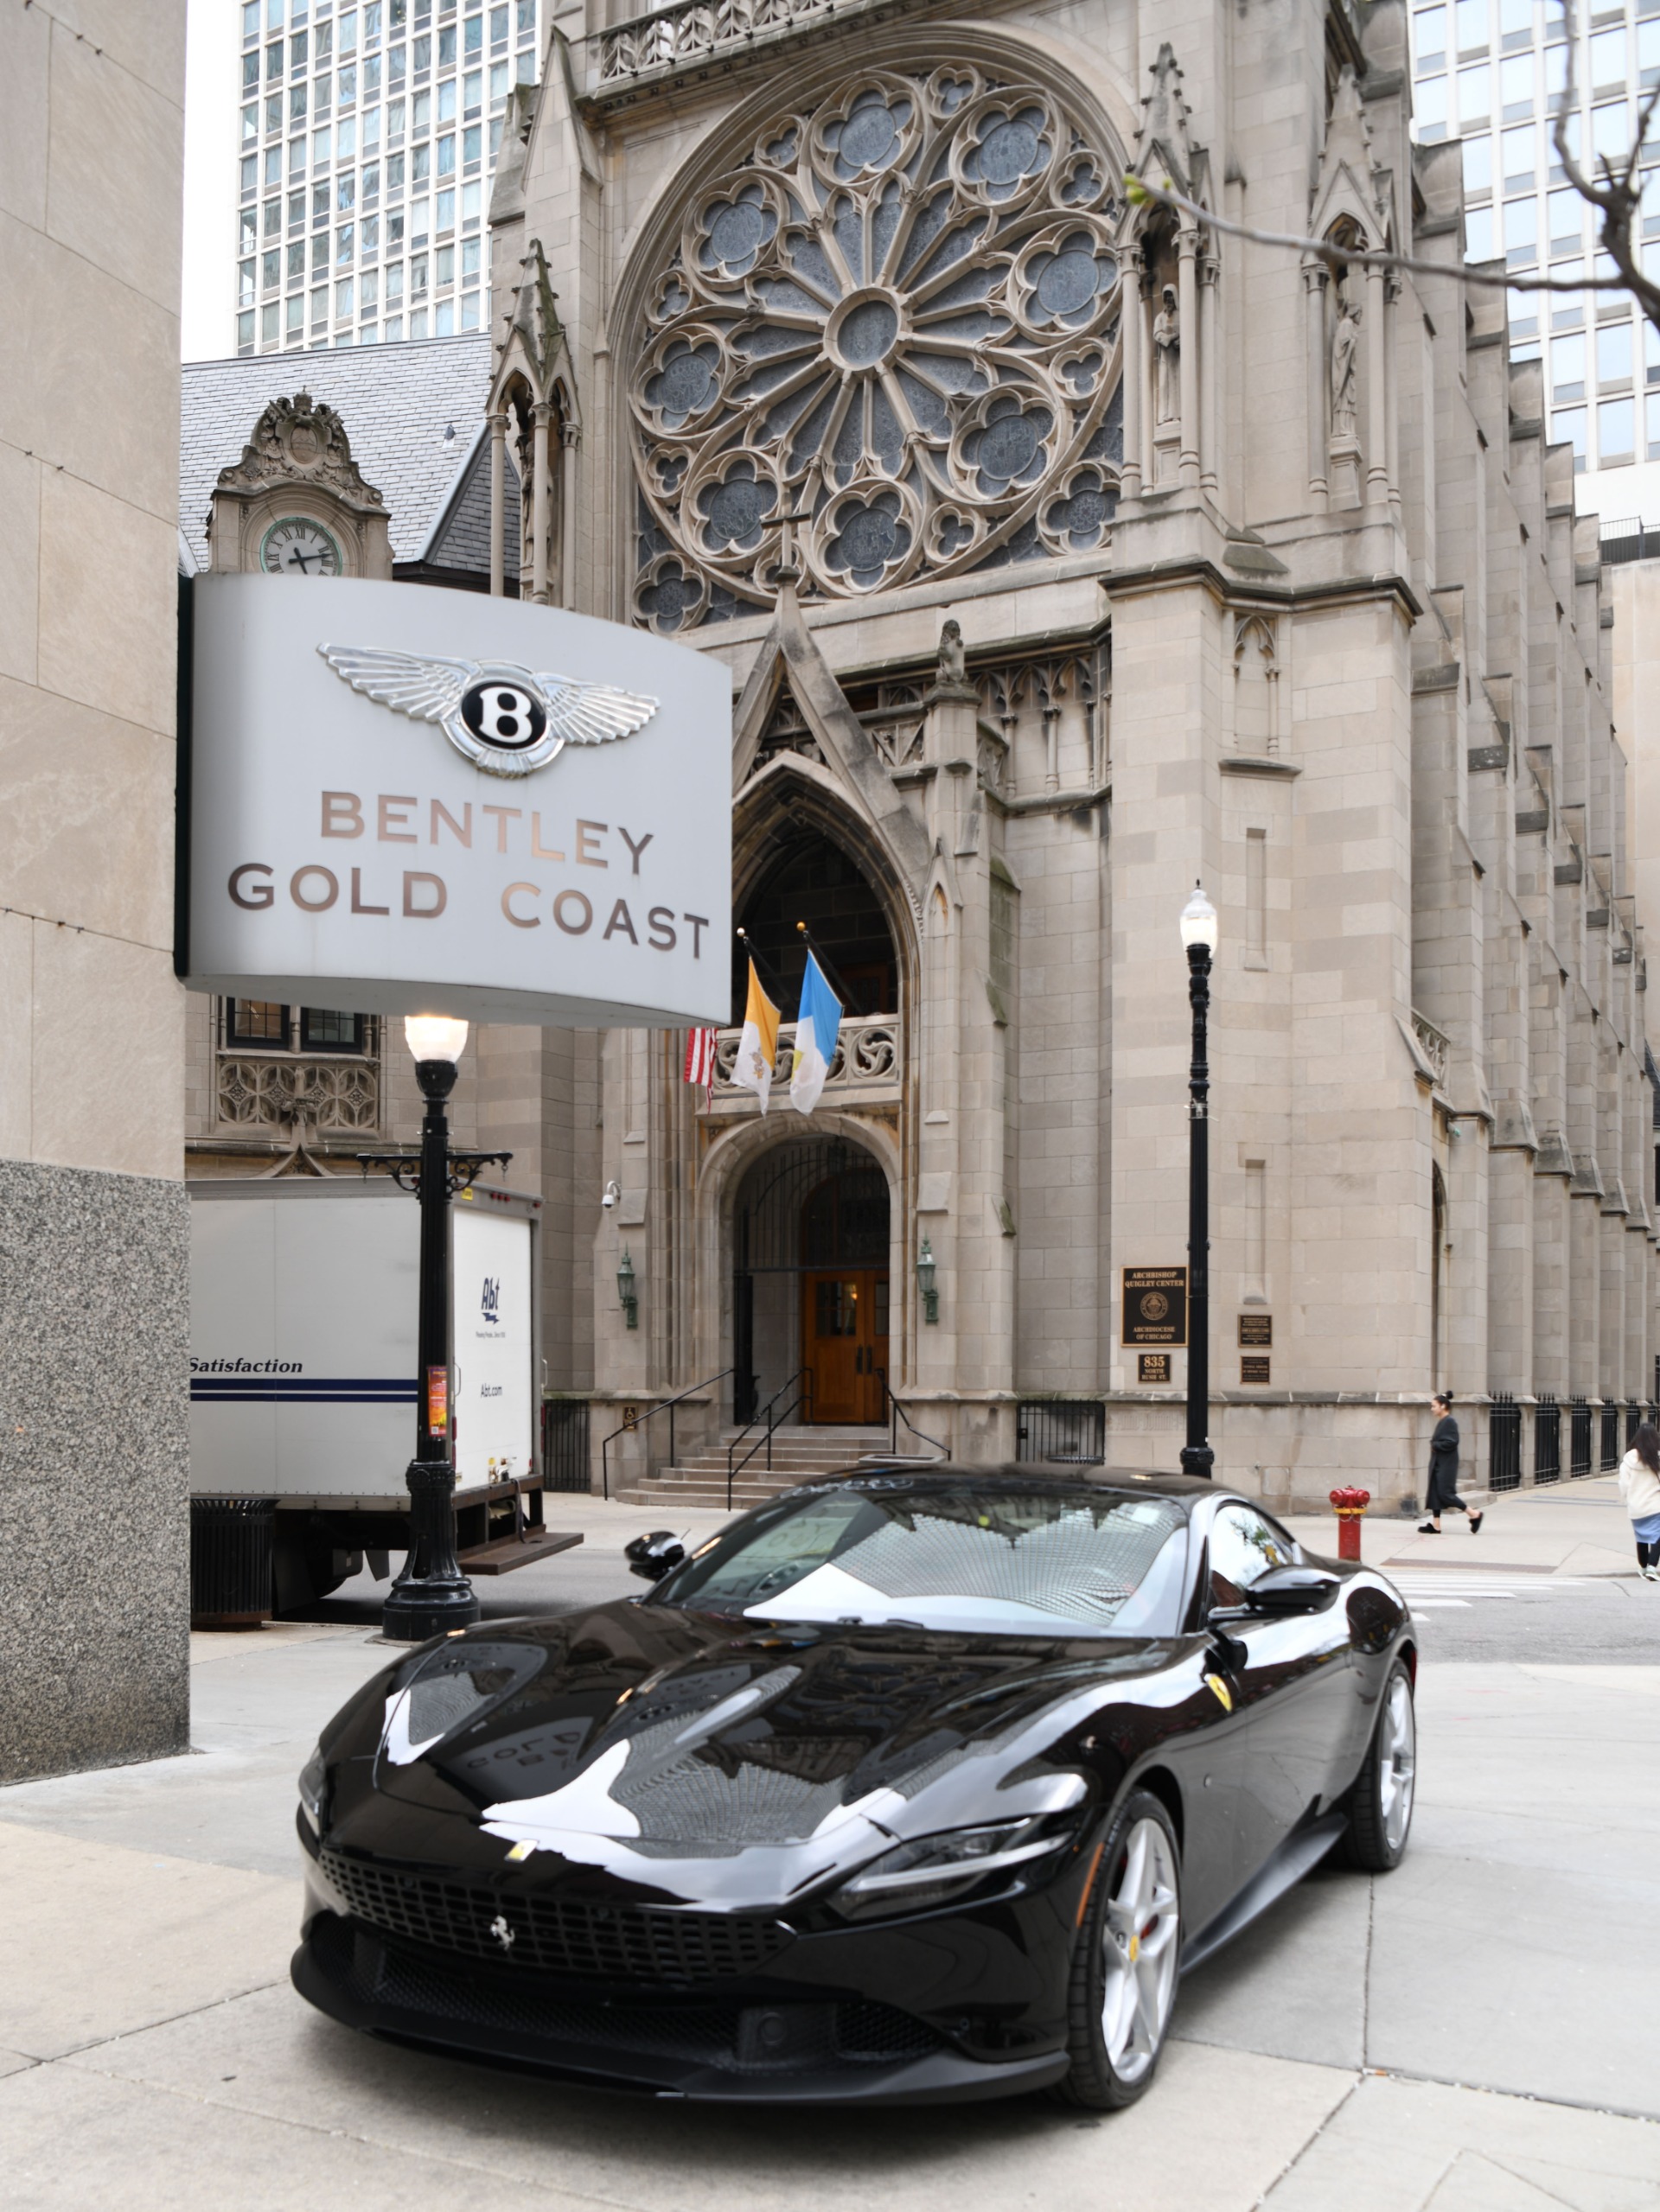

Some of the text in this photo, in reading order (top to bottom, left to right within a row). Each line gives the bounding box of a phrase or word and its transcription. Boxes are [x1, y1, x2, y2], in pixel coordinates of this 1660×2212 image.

[295, 526, 305, 539] XII
[479, 686, 533, 743] B
[321, 791, 654, 875] BENTLEY
[228, 863, 710, 959] GOLD COAST
[481, 1277, 500, 1310] Abt
[189, 1357, 303, 1373] Satisfaction
[1144, 1355, 1165, 1367] 835
[480, 1383, 503, 1398] Abt.com
